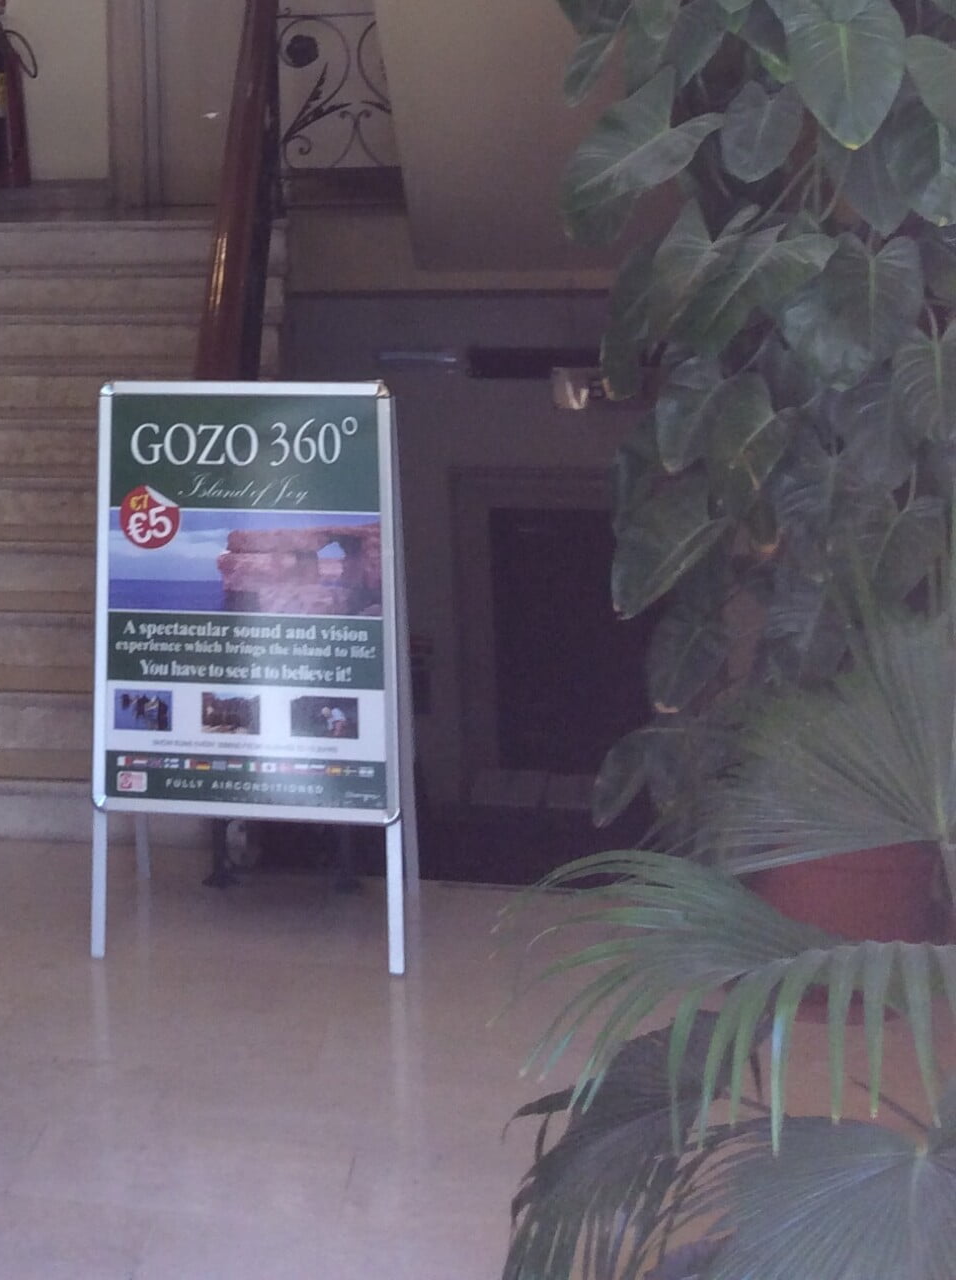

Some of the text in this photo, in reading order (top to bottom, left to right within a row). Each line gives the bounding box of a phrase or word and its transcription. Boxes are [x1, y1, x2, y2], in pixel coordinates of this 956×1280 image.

[130, 422, 260, 467] GOZO
[177, 471, 253, 499] Island
[268, 473, 309, 507] Joy
[126, 506, 173, 544] €5
[123, 620, 369, 642] A spectacular sound and vision
[115, 639, 182, 654] experience
[184, 640, 223, 653] which
[225, 642, 266, 657] brings
[269, 643, 289, 655] the
[334, 647, 348, 658] to
[350, 646, 376, 659] life!
[140, 659, 352, 683] You have to see it to believe it!
[165, 778, 324, 794] FULLY AIRCONDITIONED
